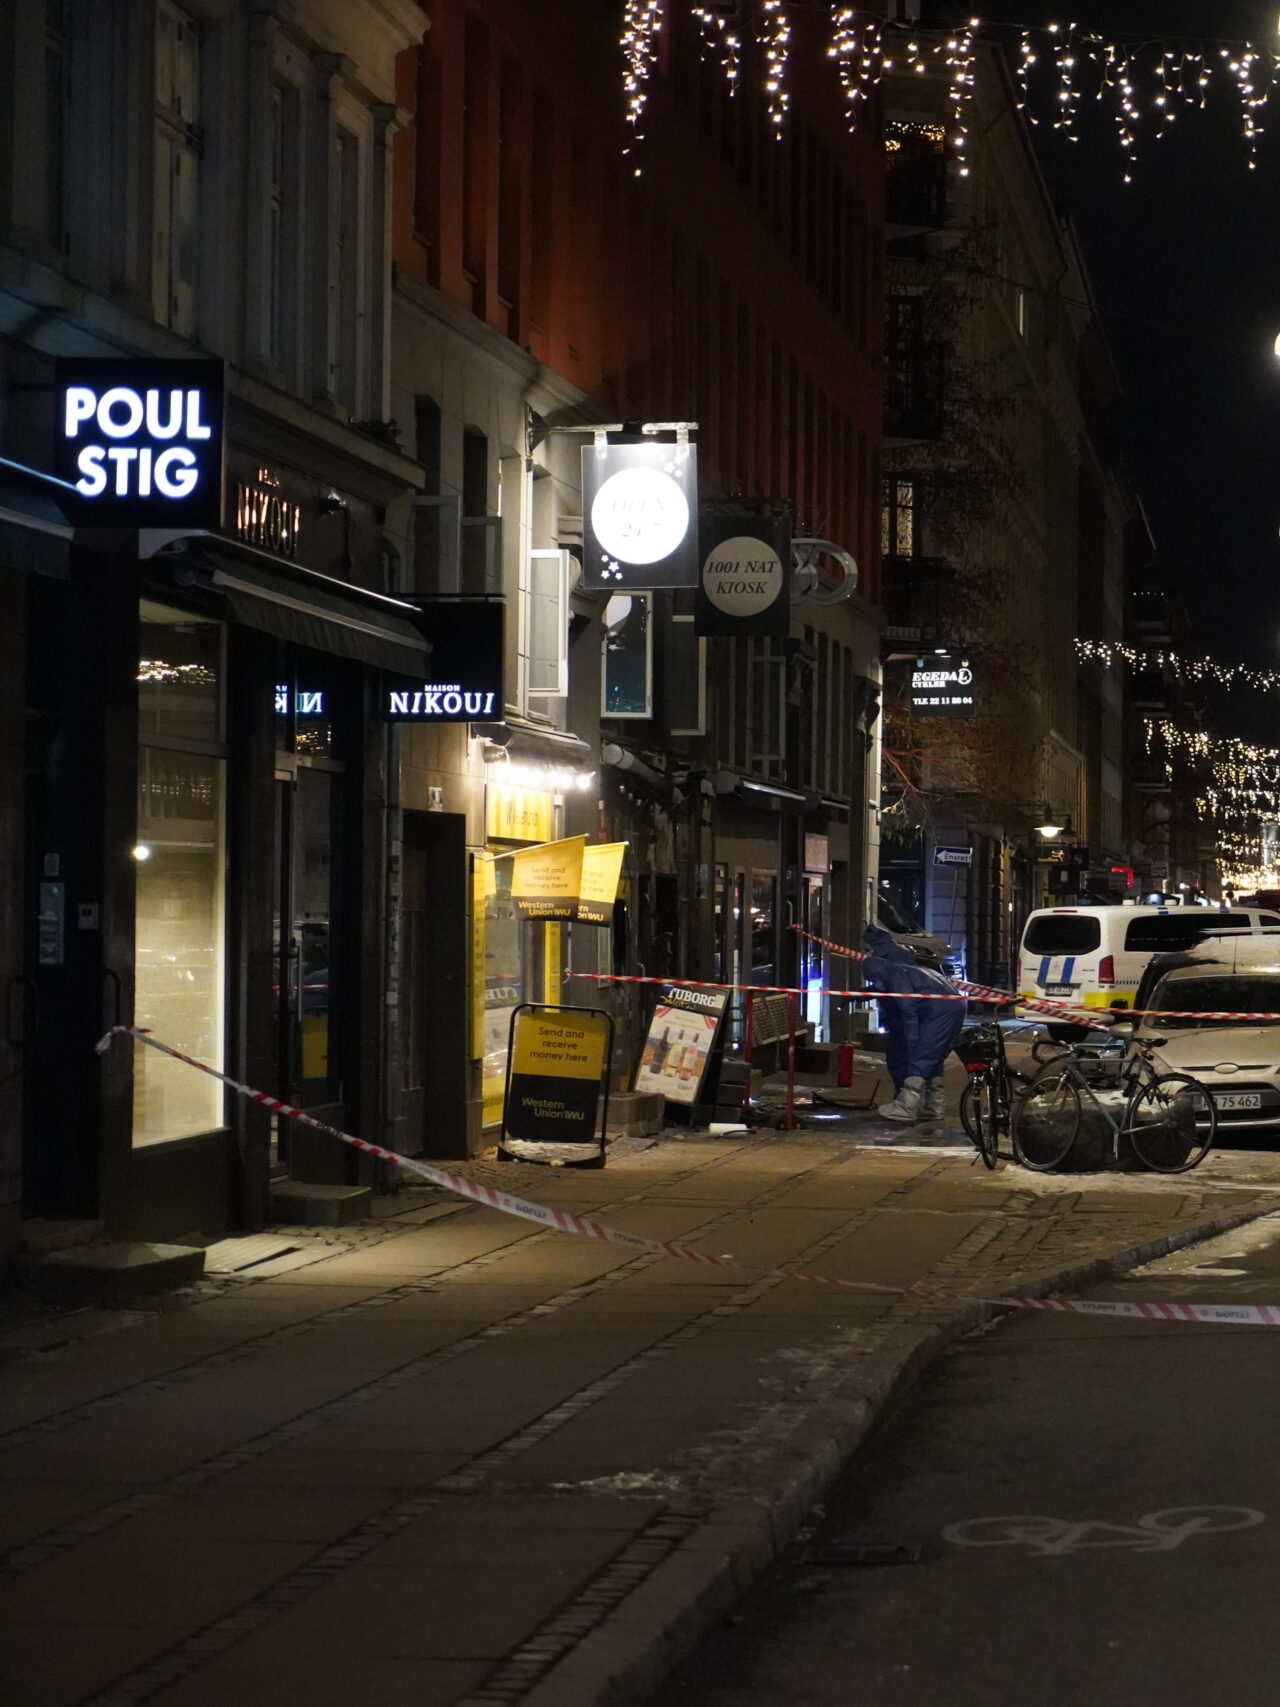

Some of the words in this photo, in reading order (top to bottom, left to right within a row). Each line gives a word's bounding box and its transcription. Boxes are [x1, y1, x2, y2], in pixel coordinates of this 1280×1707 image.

[65, 387, 211, 439] POUL
[76, 445, 198, 498] STIG
[707, 561, 740, 573] 1001
[744, 560, 778, 573] NAT
[716, 581, 768, 594] KIOSK
[912, 671, 968, 682] EGEDAL
[389, 692, 495, 713] NIKOUI
[531, 866, 550, 874] Send
[551, 866, 566, 874] and
[551, 881, 569, 889] here
[518, 901, 554, 909] Western
[528, 908, 553, 916] Union
[668, 987, 716, 1007] TUBORG
[538, 1026, 563, 1037] Send
[565, 1029, 585, 1039] and
[542, 1040, 578, 1050] receive
[529, 1051, 564, 1062] money
[565, 1052, 589, 1063] here
[521, 1096, 565, 1109] Western
[1221, 1096, 1235, 1108] 75
[1238, 1096, 1259, 1108] 462
[533, 1107, 564, 1119] Union
